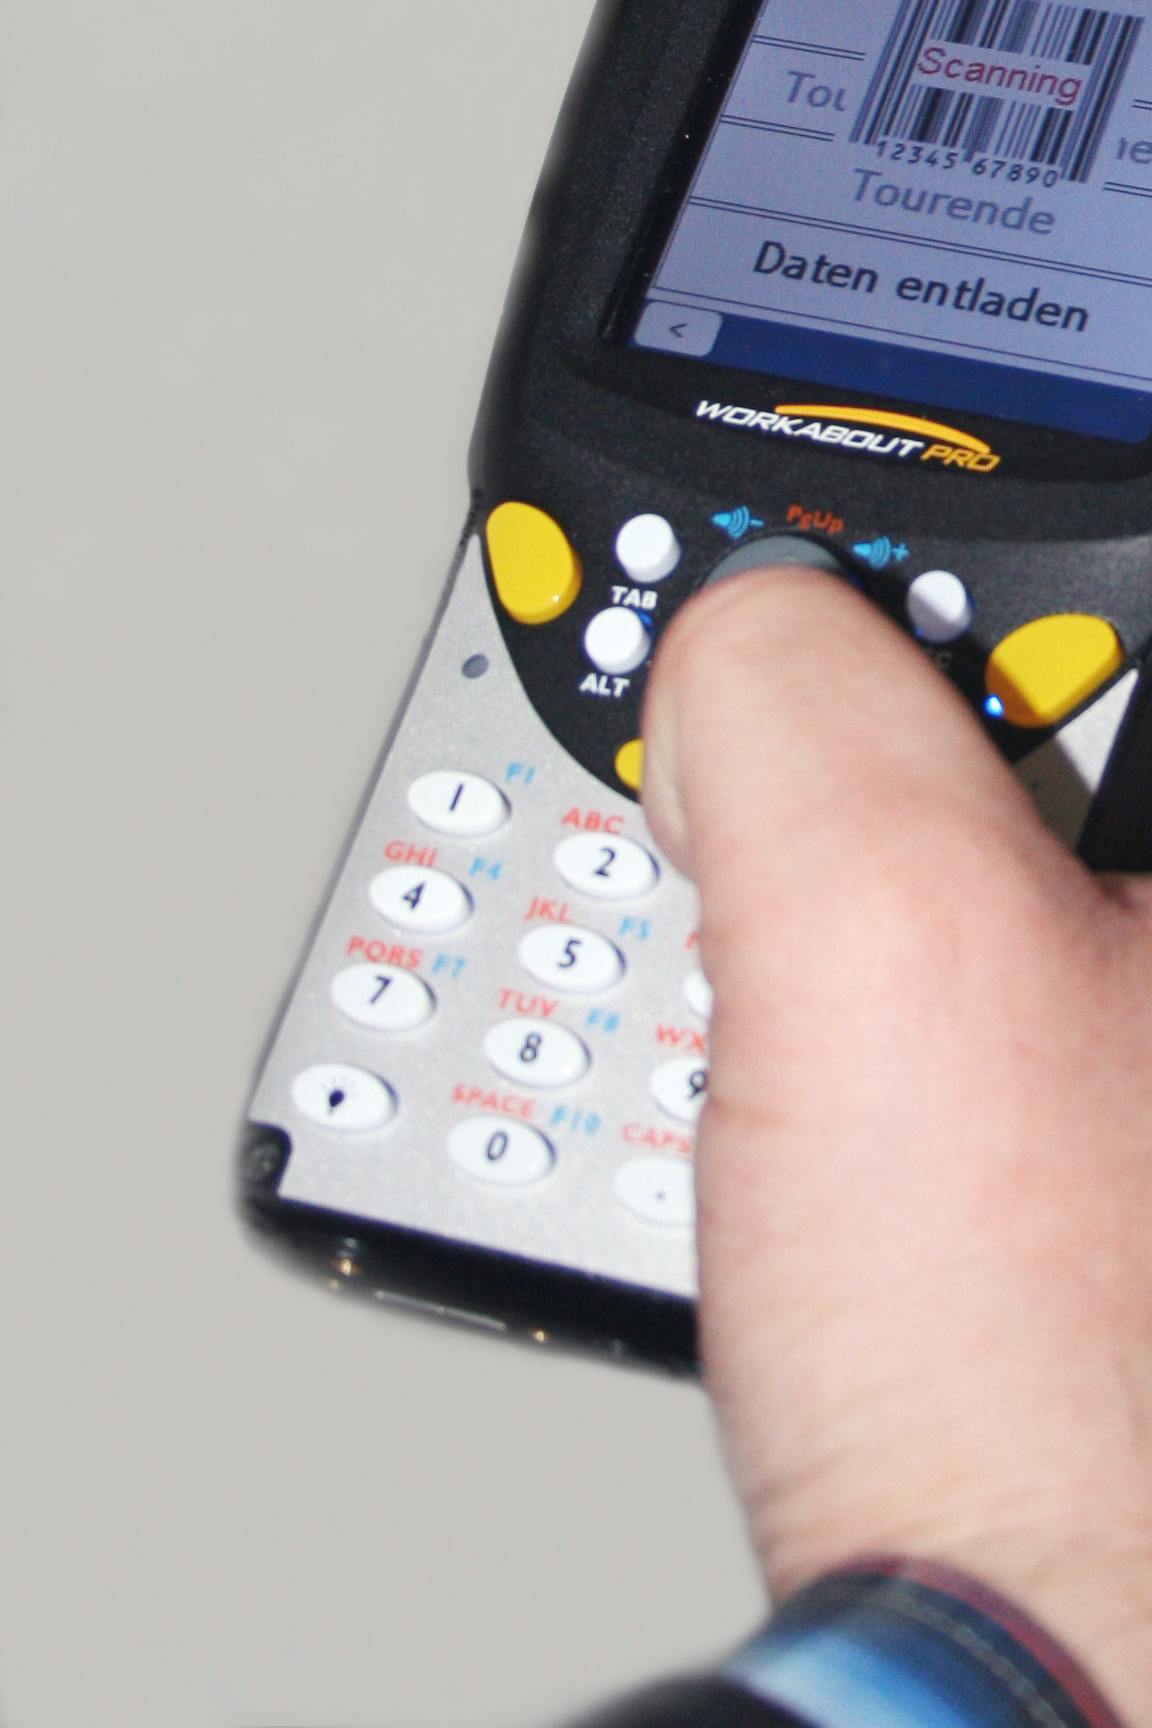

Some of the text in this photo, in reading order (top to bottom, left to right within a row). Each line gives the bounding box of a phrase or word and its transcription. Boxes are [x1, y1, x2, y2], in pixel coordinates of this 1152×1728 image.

[917, 46, 1084, 106] Scanning
[876, 140, 1058, 188] 12345 67890
[853, 168, 1057, 236] Tourende
[754, 240, 1090, 332] Daten entladen
[695, 399, 1001, 474] WORKABOUT PRO
[785, 504, 845, 534] PgUp
[611, 585, 659, 611] TAB
[579, 673, 630, 699] ALT
[505, 761, 535, 786] F1
[449, 783, 464, 812] 1
[561, 806, 626, 836] ABC
[594, 847, 616, 877] 2
[402, 881, 426, 910] 4
[525, 896, 574, 926] JKL
[557, 939, 583, 969] 5
[369, 974, 393, 1005] 7
[499, 987, 561, 1019] TUV
[519, 1032, 543, 1063] 8
[451, 1083, 538, 1119] SPACE
[688, 1071, 709, 1101] 9
[486, 1130, 509, 1162] 0
